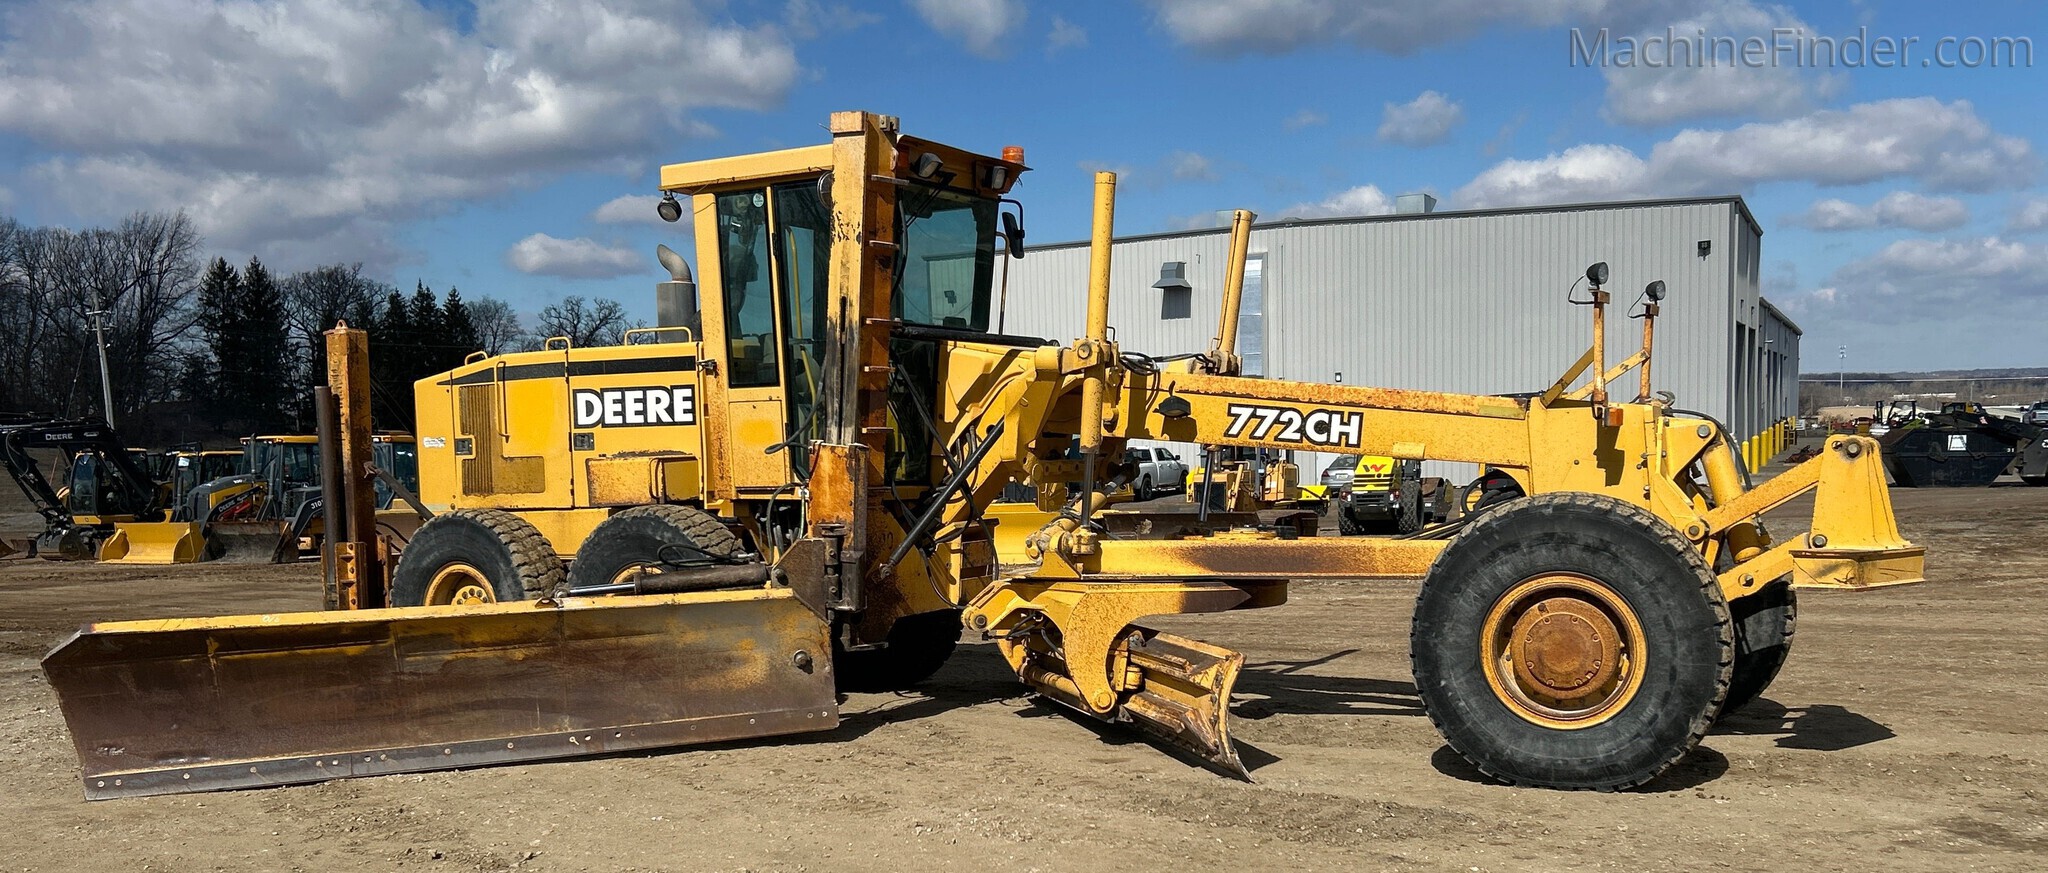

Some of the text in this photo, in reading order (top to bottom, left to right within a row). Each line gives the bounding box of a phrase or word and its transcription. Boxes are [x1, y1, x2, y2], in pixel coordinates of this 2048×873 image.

[575, 386, 695, 427] DEERE
[1226, 404, 1362, 446] 772CH
[45, 433, 73, 441] DEERE
